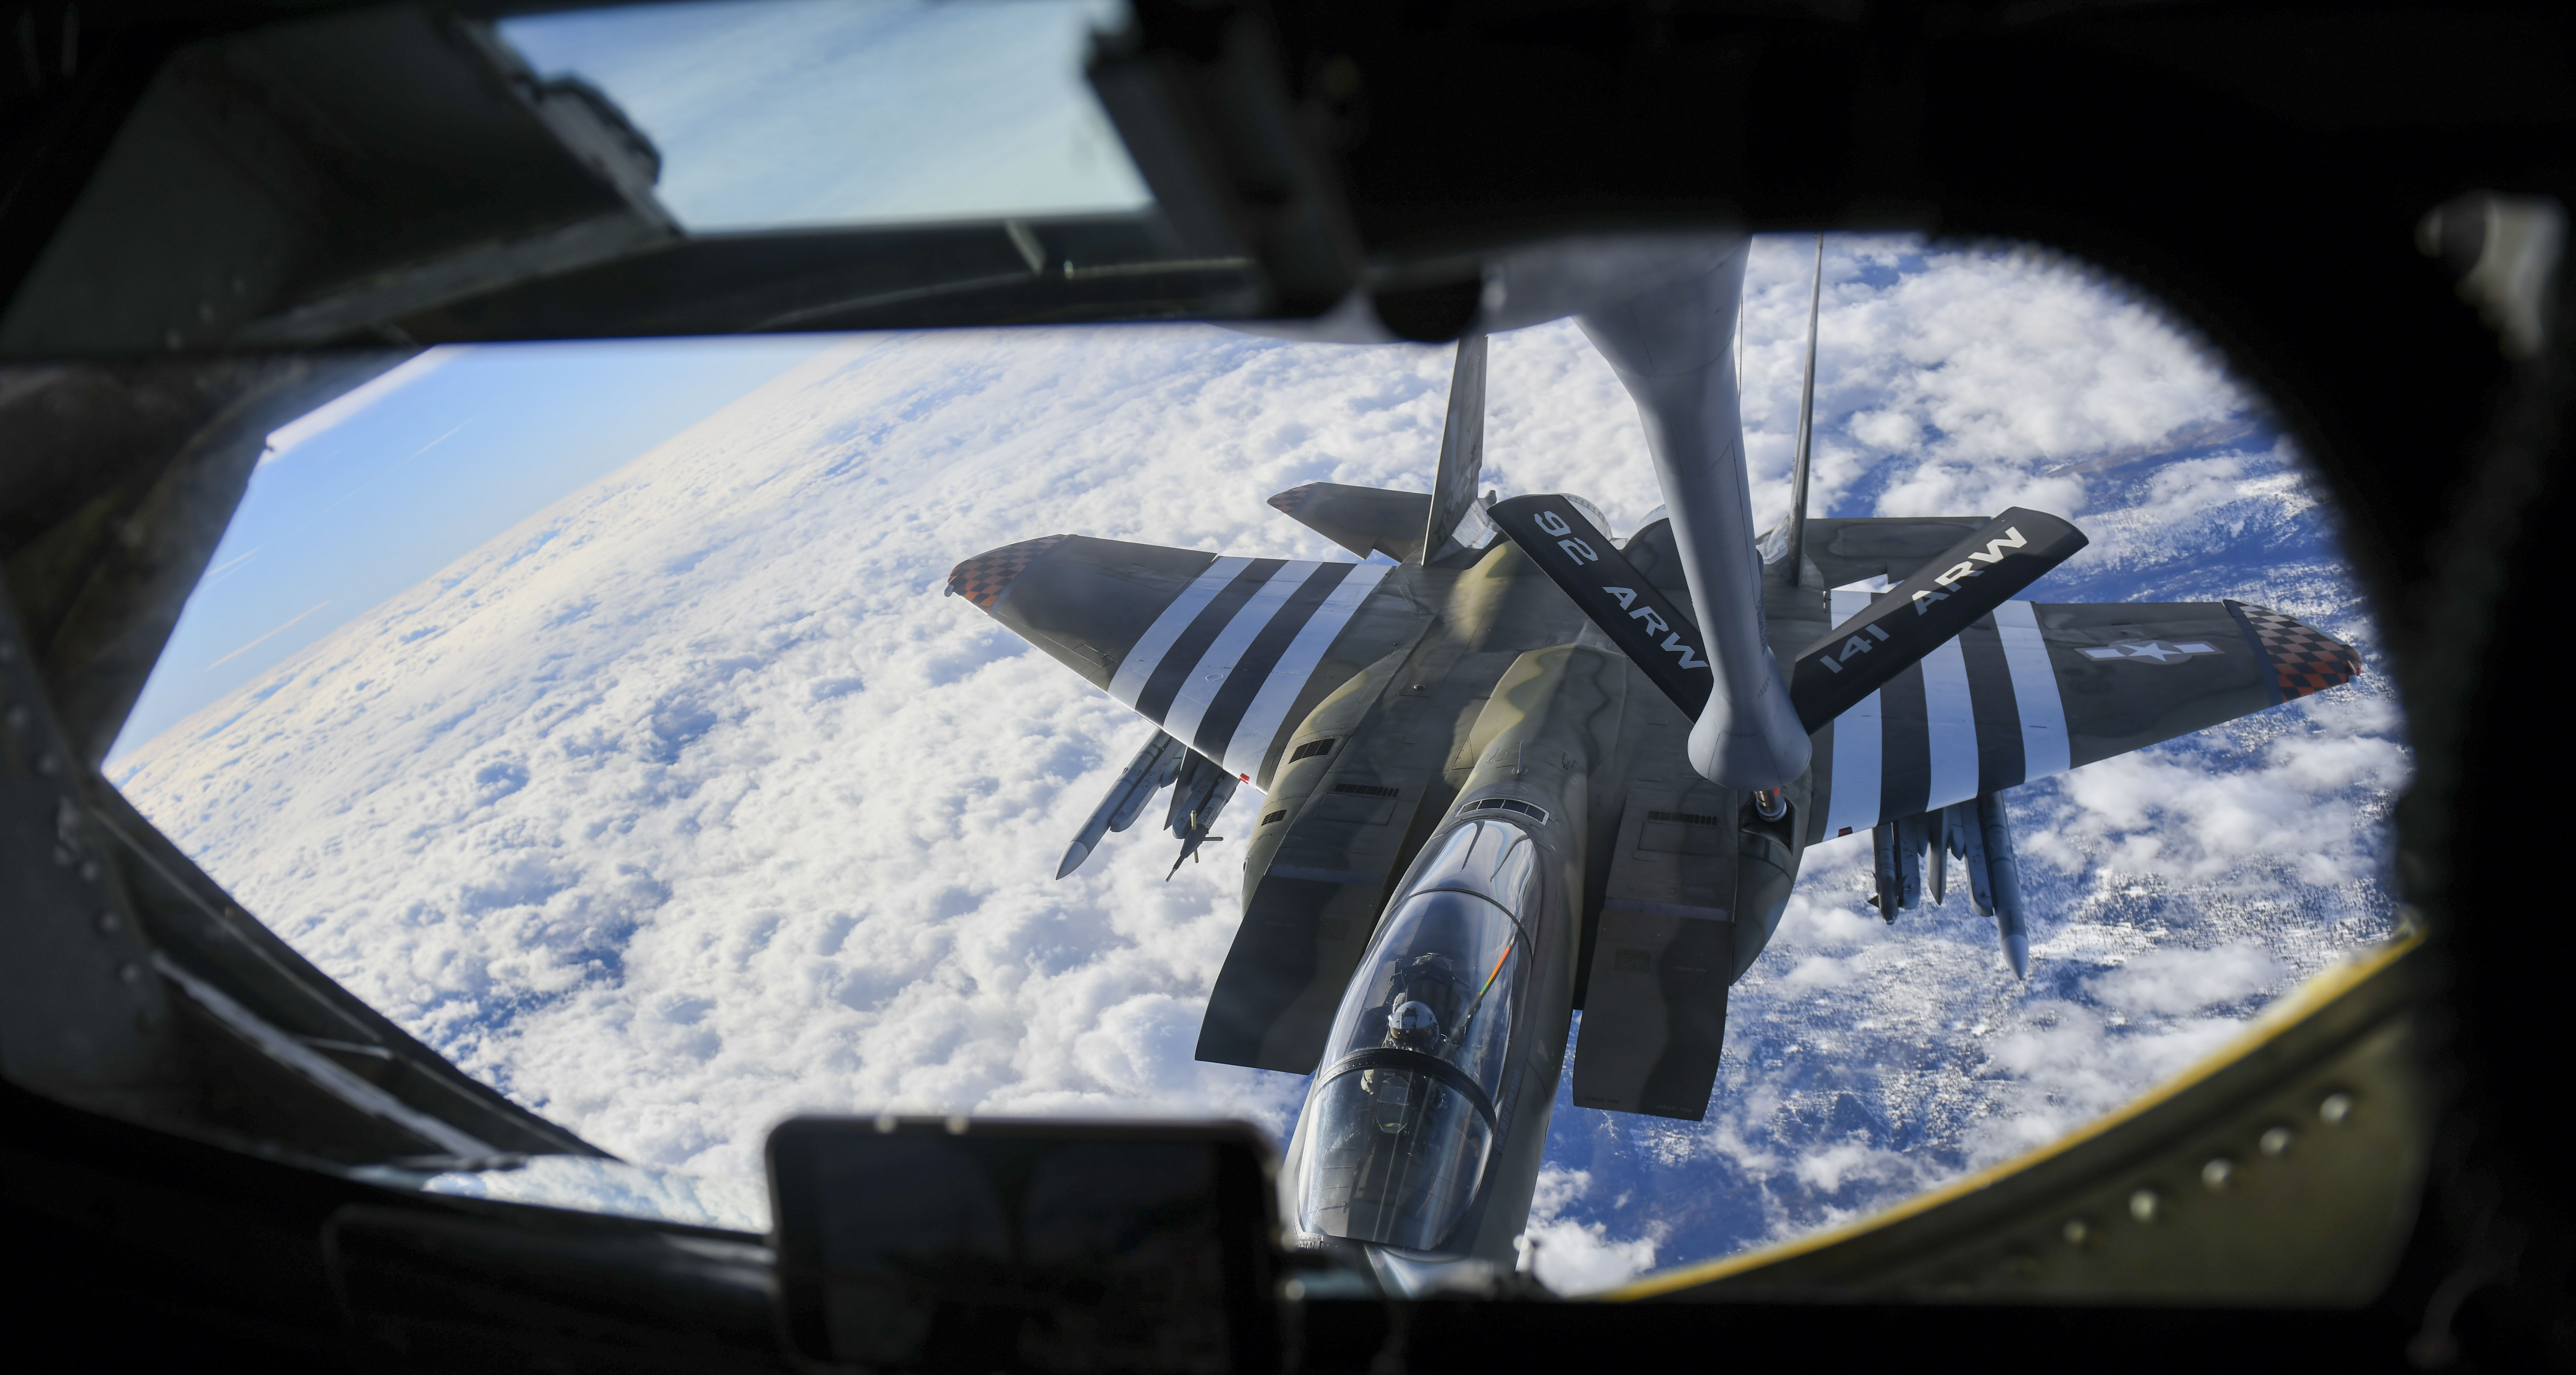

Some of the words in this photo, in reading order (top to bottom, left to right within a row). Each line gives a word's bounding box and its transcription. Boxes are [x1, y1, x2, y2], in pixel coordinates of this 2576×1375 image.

[1534, 511, 1598, 565] 92
[1602, 587, 1710, 669] ARW
[1820, 624, 1890, 673] 141
[1912, 526, 2027, 615] ARW
